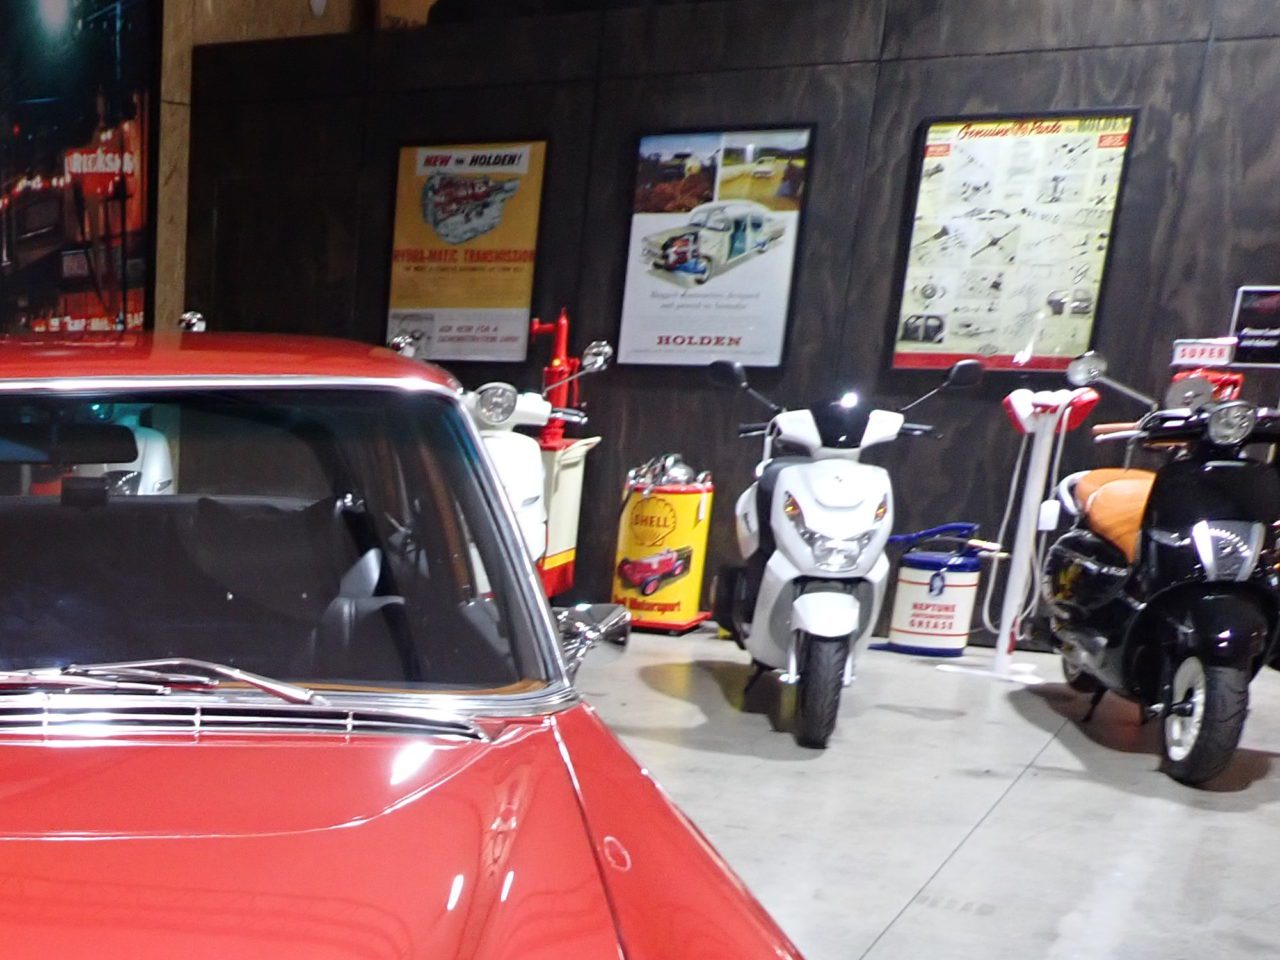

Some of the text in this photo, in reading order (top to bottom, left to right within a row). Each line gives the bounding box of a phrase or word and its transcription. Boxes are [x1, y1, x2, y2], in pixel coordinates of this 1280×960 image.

[424, 155, 452, 167] NEW
[469, 154, 522, 167] HOLDEN!
[464, 248, 535, 263] TRANSMISSION
[656, 335, 743, 347] HOLDEN
[1180, 347, 1225, 359] SUPER
[634, 514, 670, 528] SHELL
[912, 602, 957, 613] NEPTUNE
[909, 619, 953, 630] GREASE
